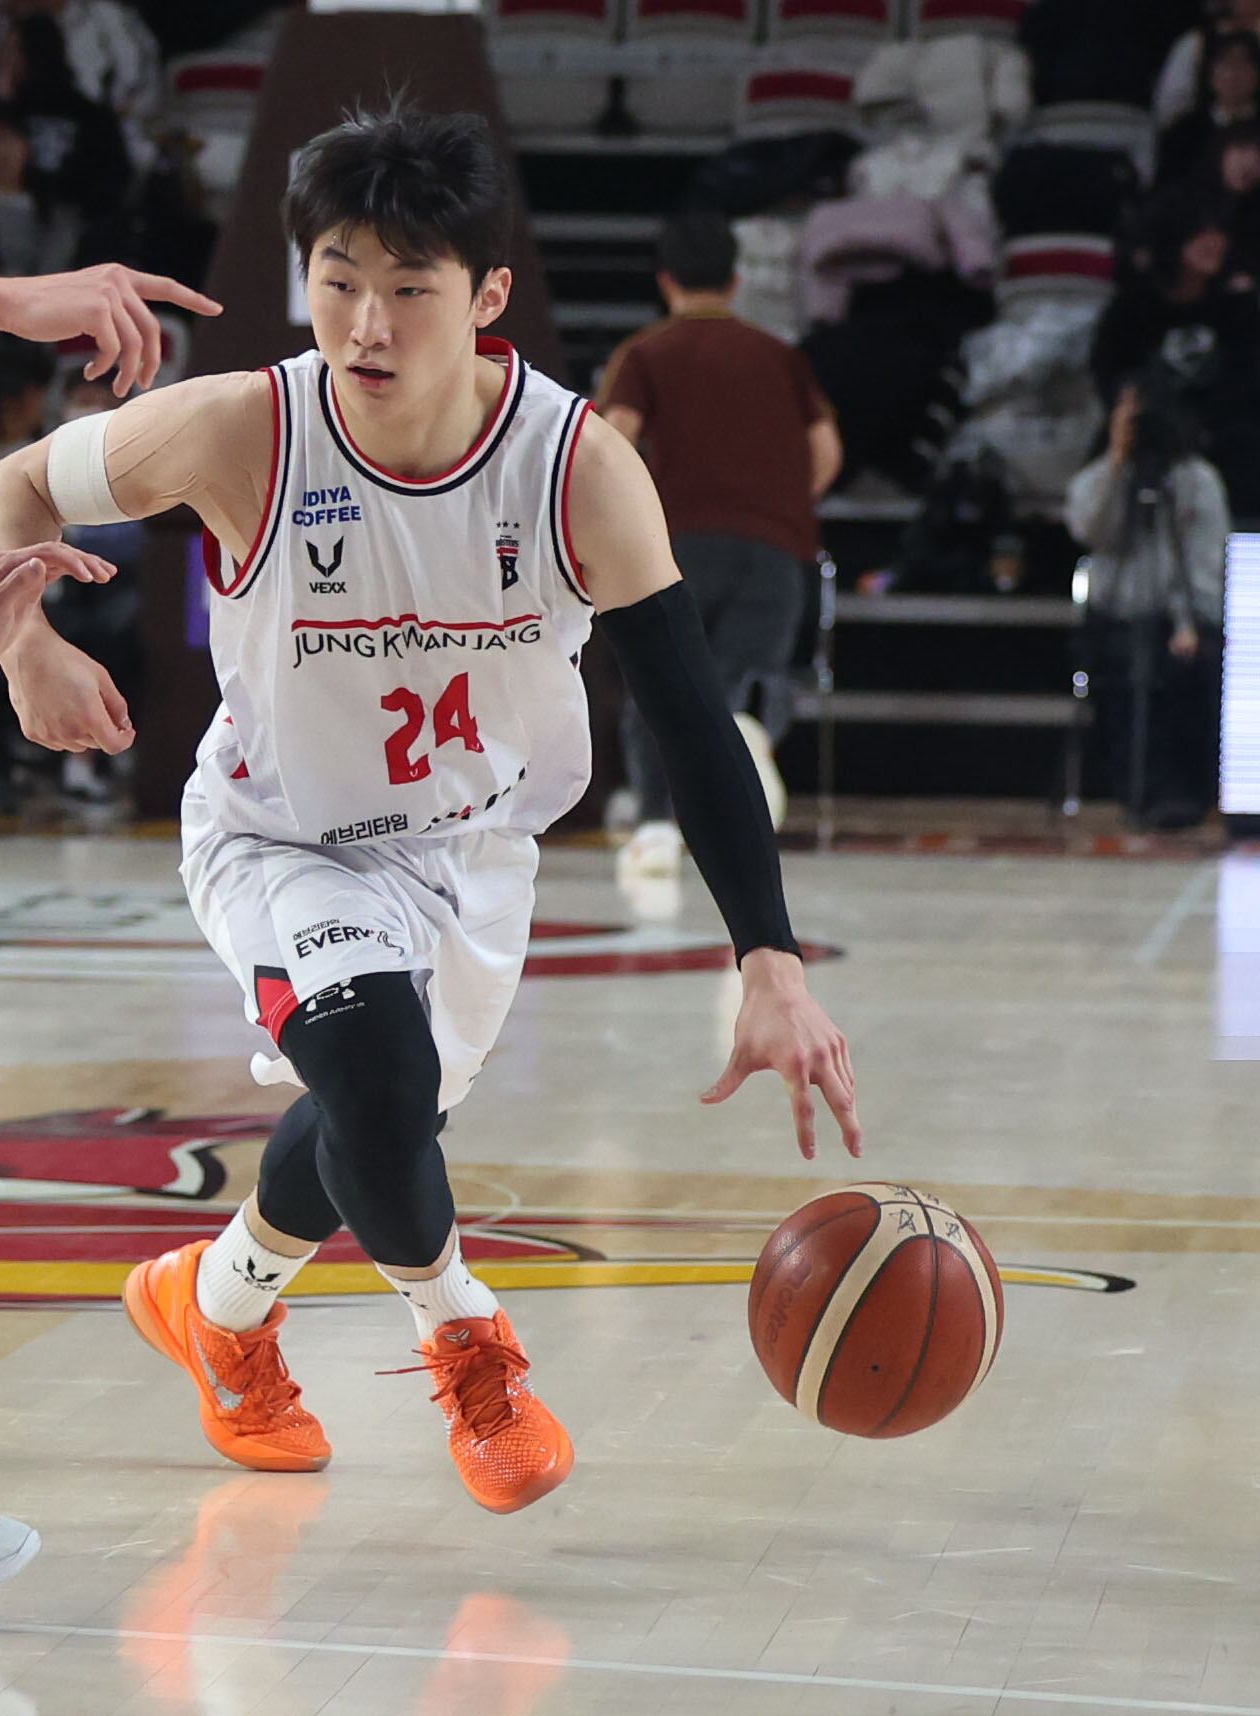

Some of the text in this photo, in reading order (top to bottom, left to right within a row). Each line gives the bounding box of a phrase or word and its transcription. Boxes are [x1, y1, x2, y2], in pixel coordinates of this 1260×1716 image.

[303, 486, 352, 507] IDIYA
[292, 506, 361, 527] COFFEE
[309, 582, 347, 594] VEXX
[380, 671, 485, 785] 24
[320, 813, 409, 846] 에브리타임
